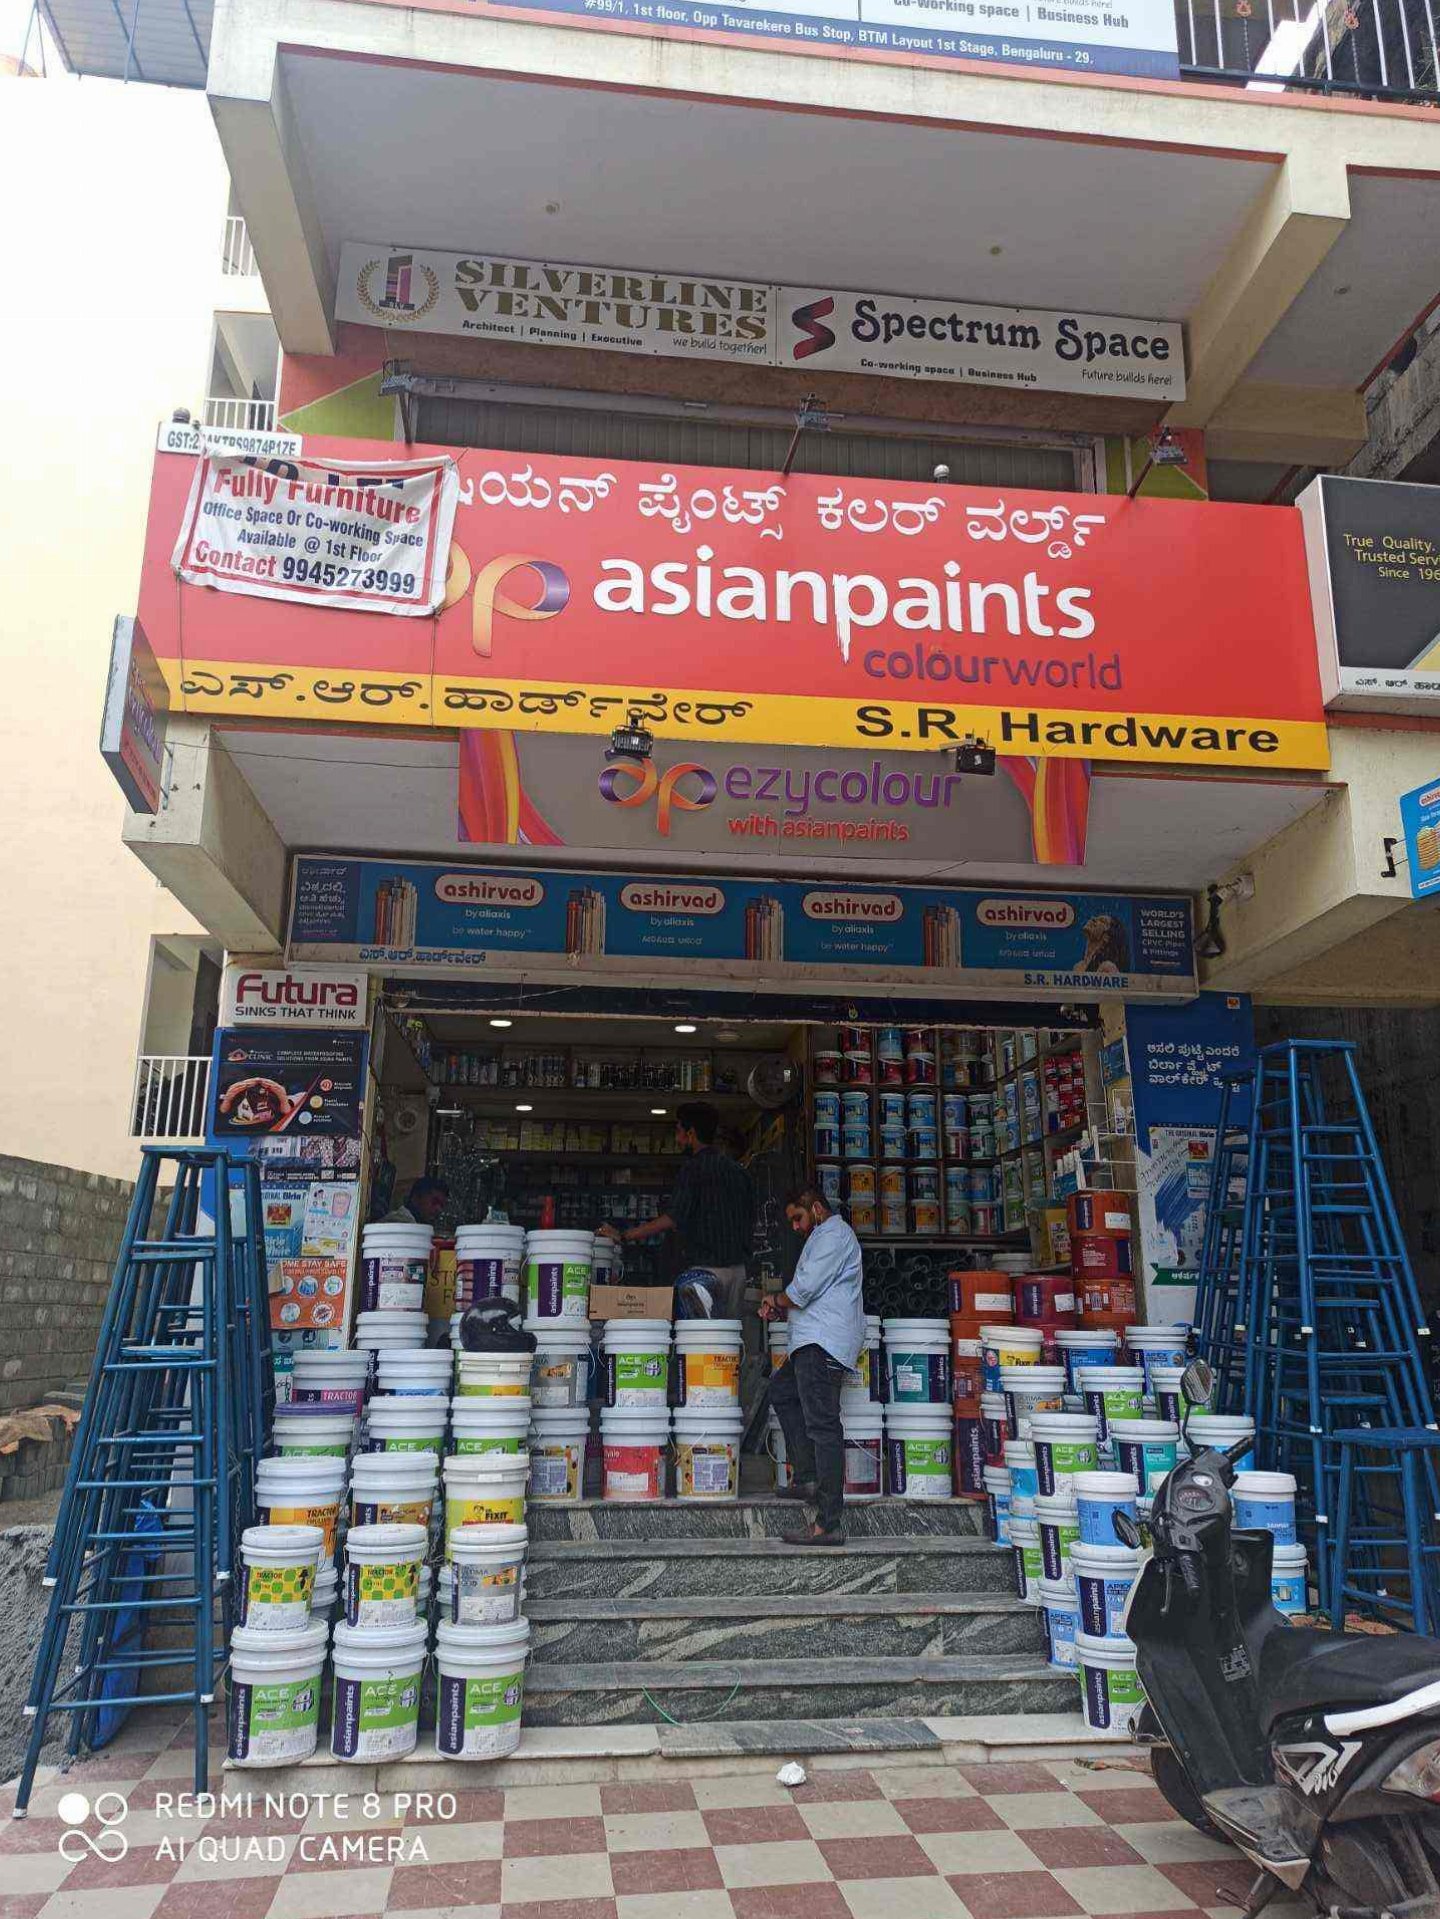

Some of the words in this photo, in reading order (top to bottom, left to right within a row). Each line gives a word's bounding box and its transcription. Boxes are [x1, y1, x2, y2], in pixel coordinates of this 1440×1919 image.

[979, 5, 1020, 19] space
[1037, 7, 1099, 26] Business
[1103, 14, 1129, 28] Hub
[634, 5, 653, 16] 1st
[656, 6, 688, 22] floor,
[693, 11, 718, 27] Opp
[722, 13, 791, 34] Tavarekere
[795, 19, 819, 36] Bus
[822, 25, 854, 42] Stop,
[858, 29, 888, 44] BTM
[892, 33, 933, 50] Layout
[937, 38, 956, 51] 1st
[959, 40, 998, 57] Stage,
[1002, 43, 1065, 62] Bengaluru
[455, 258, 769, 315] SILVERLINE
[455, 286, 768, 341] VENTURES
[462, 320, 515, 335] Architect
[529, 326, 577, 341] Planning
[591, 333, 643, 347] Executive
[851, 299, 1042, 350] Spectrum
[1055, 318, 1171, 362] Space
[672, 338, 687, 347] we
[689, 336, 717, 350] build
[718, 339, 768, 355] together!
[860, 358, 921, 373] Co-working
[924, 366, 955, 377] space
[968, 367, 1013, 380] Business
[1017, 372, 1037, 383] Hub
[1082, 368, 1113, 383] Future
[1116, 370, 1146, 384] builds
[1148, 373, 1173, 386] here!
[213, 468, 279, 504] Fully
[288, 481, 421, 524] Furniture
[817, 487, 946, 535] ಕಲರ್
[203, 502, 242, 521] Office
[246, 506, 283, 525] Space
[287, 511, 302, 526] Or
[305, 513, 381, 545] Co-working
[384, 530, 424, 547] Space
[237, 528, 296, 549] Available
[304, 536, 321, 554] @
[326, 539, 346, 558] 1st
[350, 545, 384, 563] Floor
[1343, 533, 1374, 548] True
[1382, 536, 1436, 553] Quality.
[195, 540, 277, 577] Contact
[282, 556, 415, 594] 9945273999
[1354, 549, 1406, 564] Trusted
[1378, 567, 1410, 579] Since
[593, 544, 1096, 664] asianpaints
[863, 642, 1123, 690] colourworld
[1001, 711, 1280, 753] Hardware
[724, 762, 964, 817] ezycolour
[728, 816, 778, 838] with
[782, 818, 909, 844] asianpaints
[443, 879, 536, 901] ashirvad
[629, 889, 717, 909] ashirvad
[810, 898, 896, 917] ashirvad
[985, 904, 1068, 924] ashirvad
[466, 926, 495, 936] water
[1140, 919, 1184, 928] LARGEST
[1142, 929, 1185, 938] SELLING
[236, 973, 358, 1007] Futura
[1024, 973, 1049, 986] S.R.
[1053, 975, 1129, 988] HARDWARE
[235, 1006, 276, 1017] SINKS
[280, 1007, 314, 1018] THAT
[318, 1008, 357, 1020] THINK
[567, 1266, 588, 1274] ACE
[619, 1356, 642, 1365] ACE
[323, 1391, 357, 1400] TRACTOR
[388, 1442, 417, 1451] ACE
[459, 1442, 482, 1451] ACE
[907, 1443, 932, 1451] ACE
[255, 1687, 290, 1700] ACE
[365, 1684, 398, 1697] ACE
[469, 1682, 502, 1694] ACE
[236, 1687, 246, 1757] asianpaints
[344, 1684, 354, 1753] asianpaints
[451, 1682, 460, 1750] asianpaints
